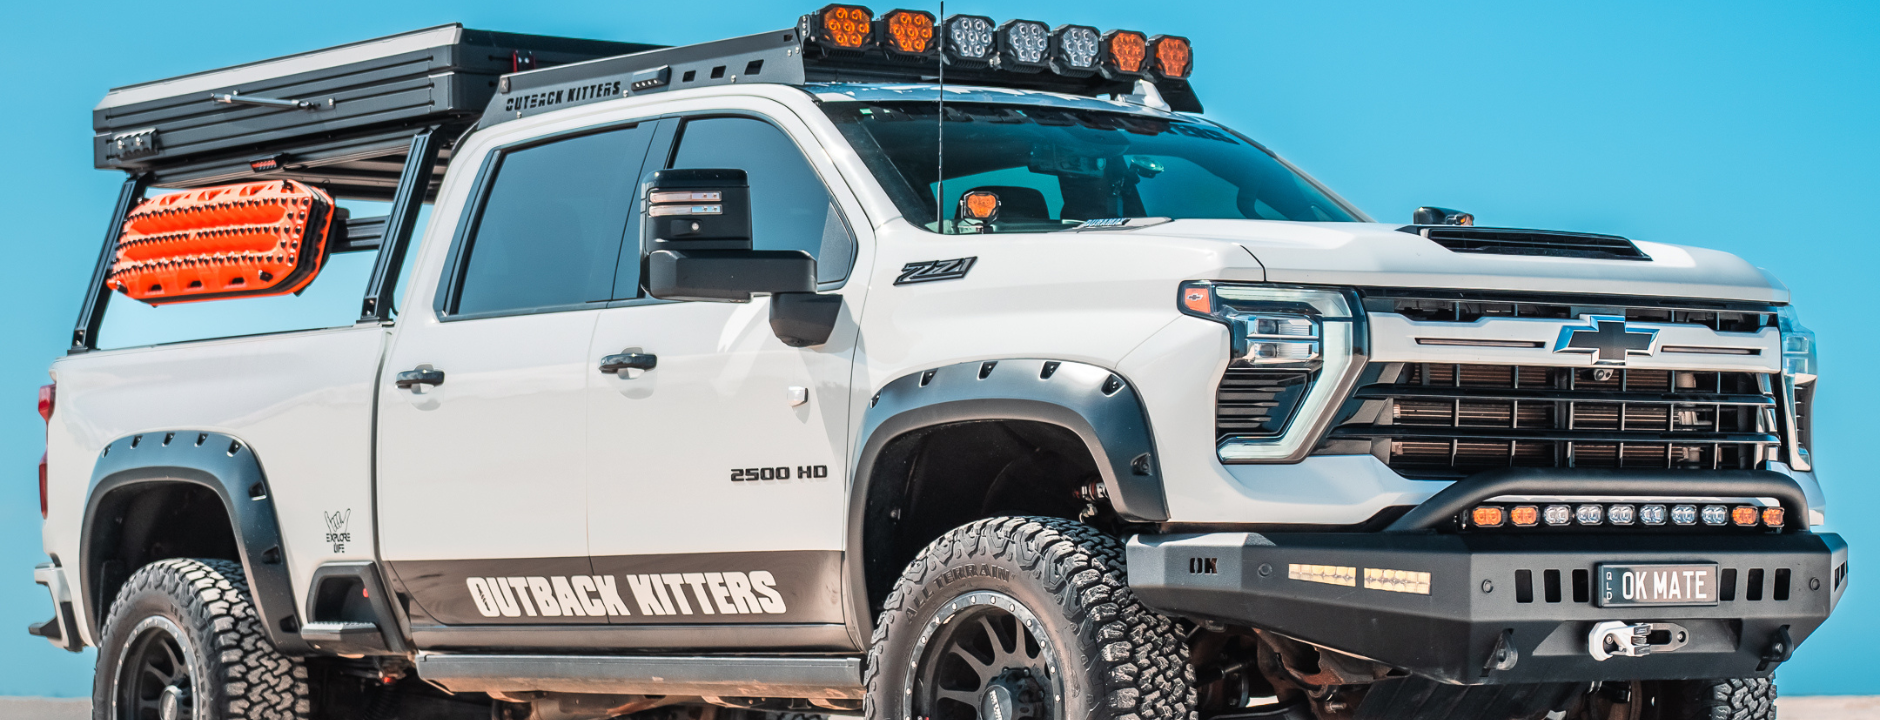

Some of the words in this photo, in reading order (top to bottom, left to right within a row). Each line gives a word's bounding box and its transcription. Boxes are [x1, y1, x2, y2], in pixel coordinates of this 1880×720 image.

[505, 89, 564, 112] OUTBACK
[566, 80, 621, 103] KITTERS
[730, 466, 790, 482] 2500
[797, 464, 828, 479] HD
[1189, 557, 1218, 574] OK
[466, 574, 631, 618] OUTBACK
[626, 570, 787, 616] KITTERS
[905, 587, 935, 624] ALL
[933, 563, 1010, 592] TERRAIN
[1622, 571, 1648, 600] OK
[1653, 571, 1708, 600] MATE
